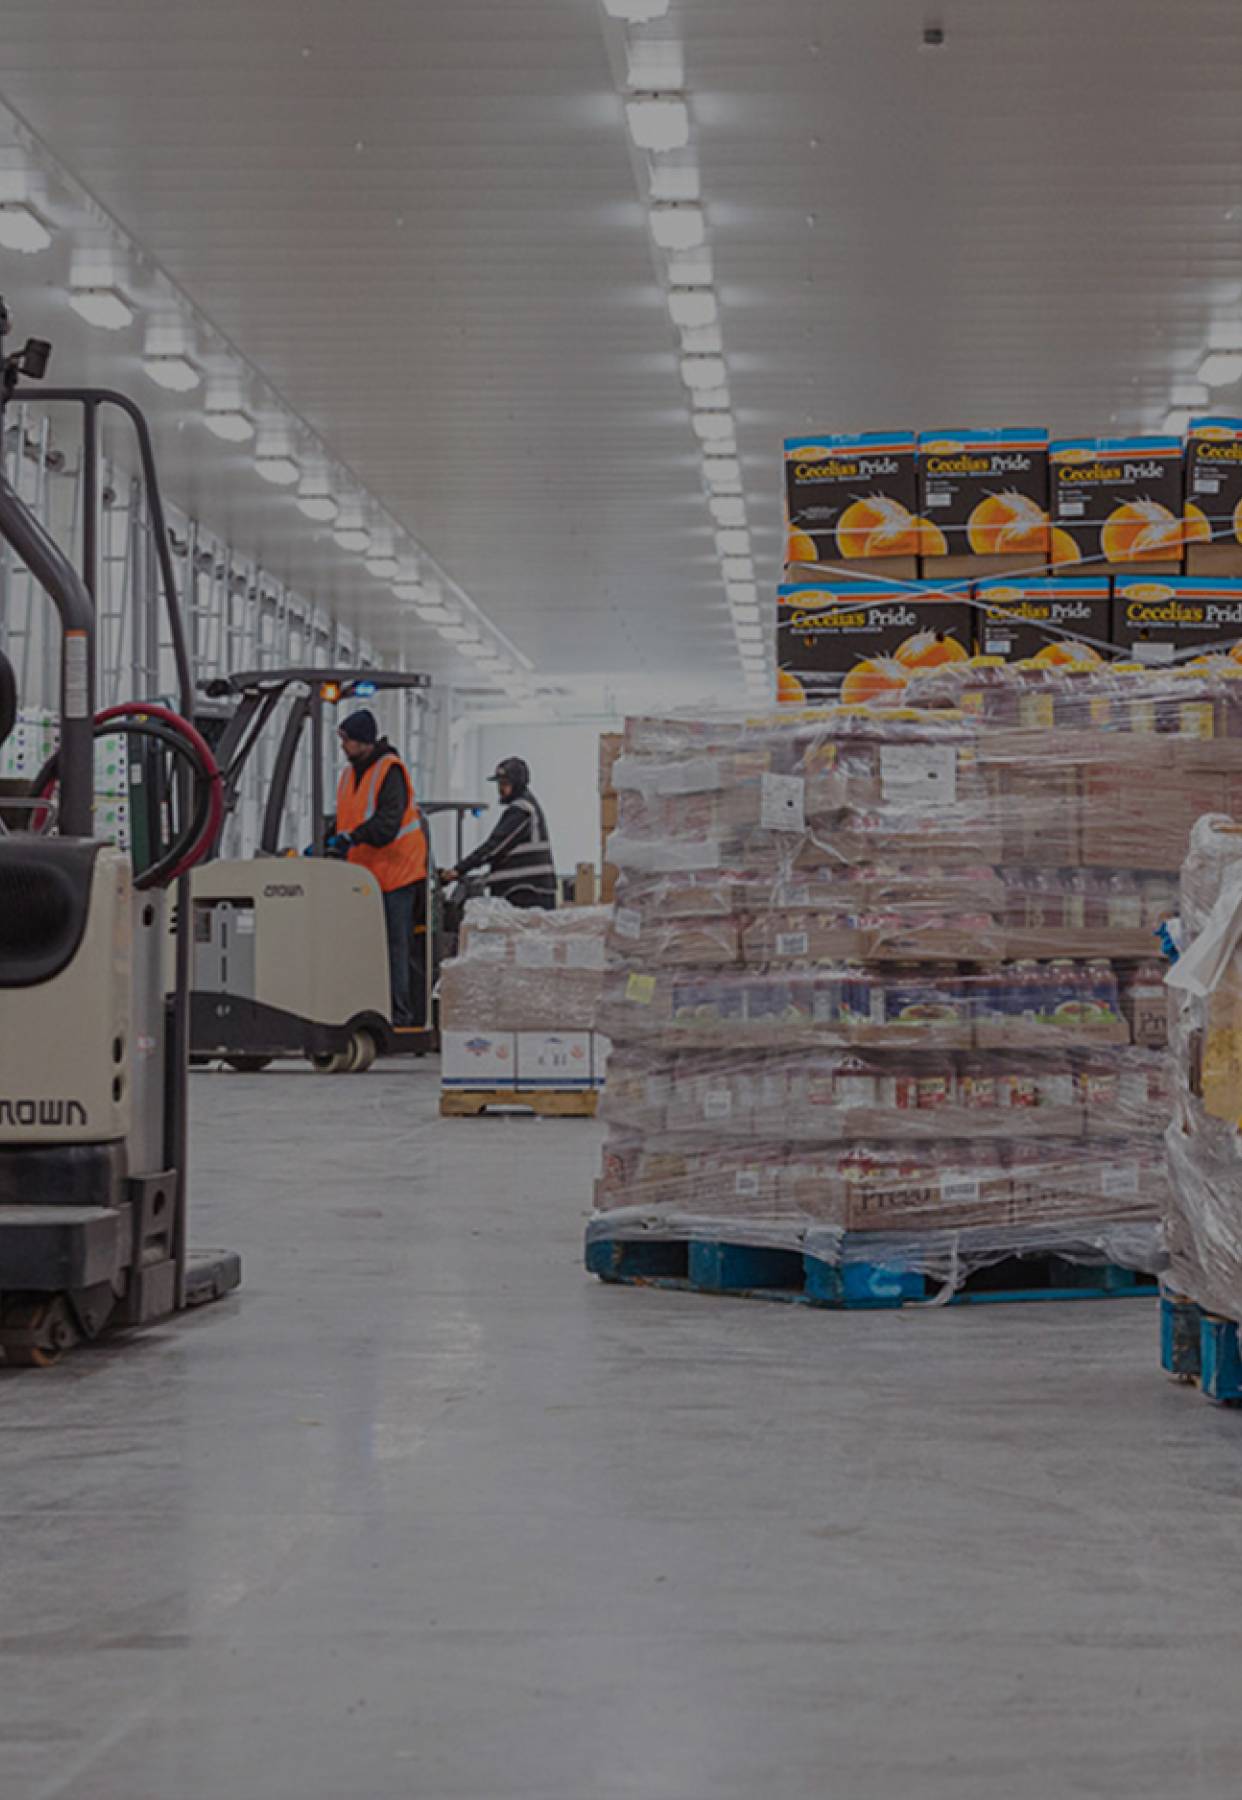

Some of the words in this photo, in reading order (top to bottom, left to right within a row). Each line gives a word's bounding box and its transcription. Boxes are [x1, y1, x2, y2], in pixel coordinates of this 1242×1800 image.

[859, 457, 899, 474] Pride
[991, 453, 1031, 471] Pride
[1123, 460, 1164, 479] Pride
[868, 605, 917, 625] Pride
[1051, 601, 1092, 618] Pride
[1205, 603, 1242, 622] Prid
[0, 1099, 87, 1126] ROWN
